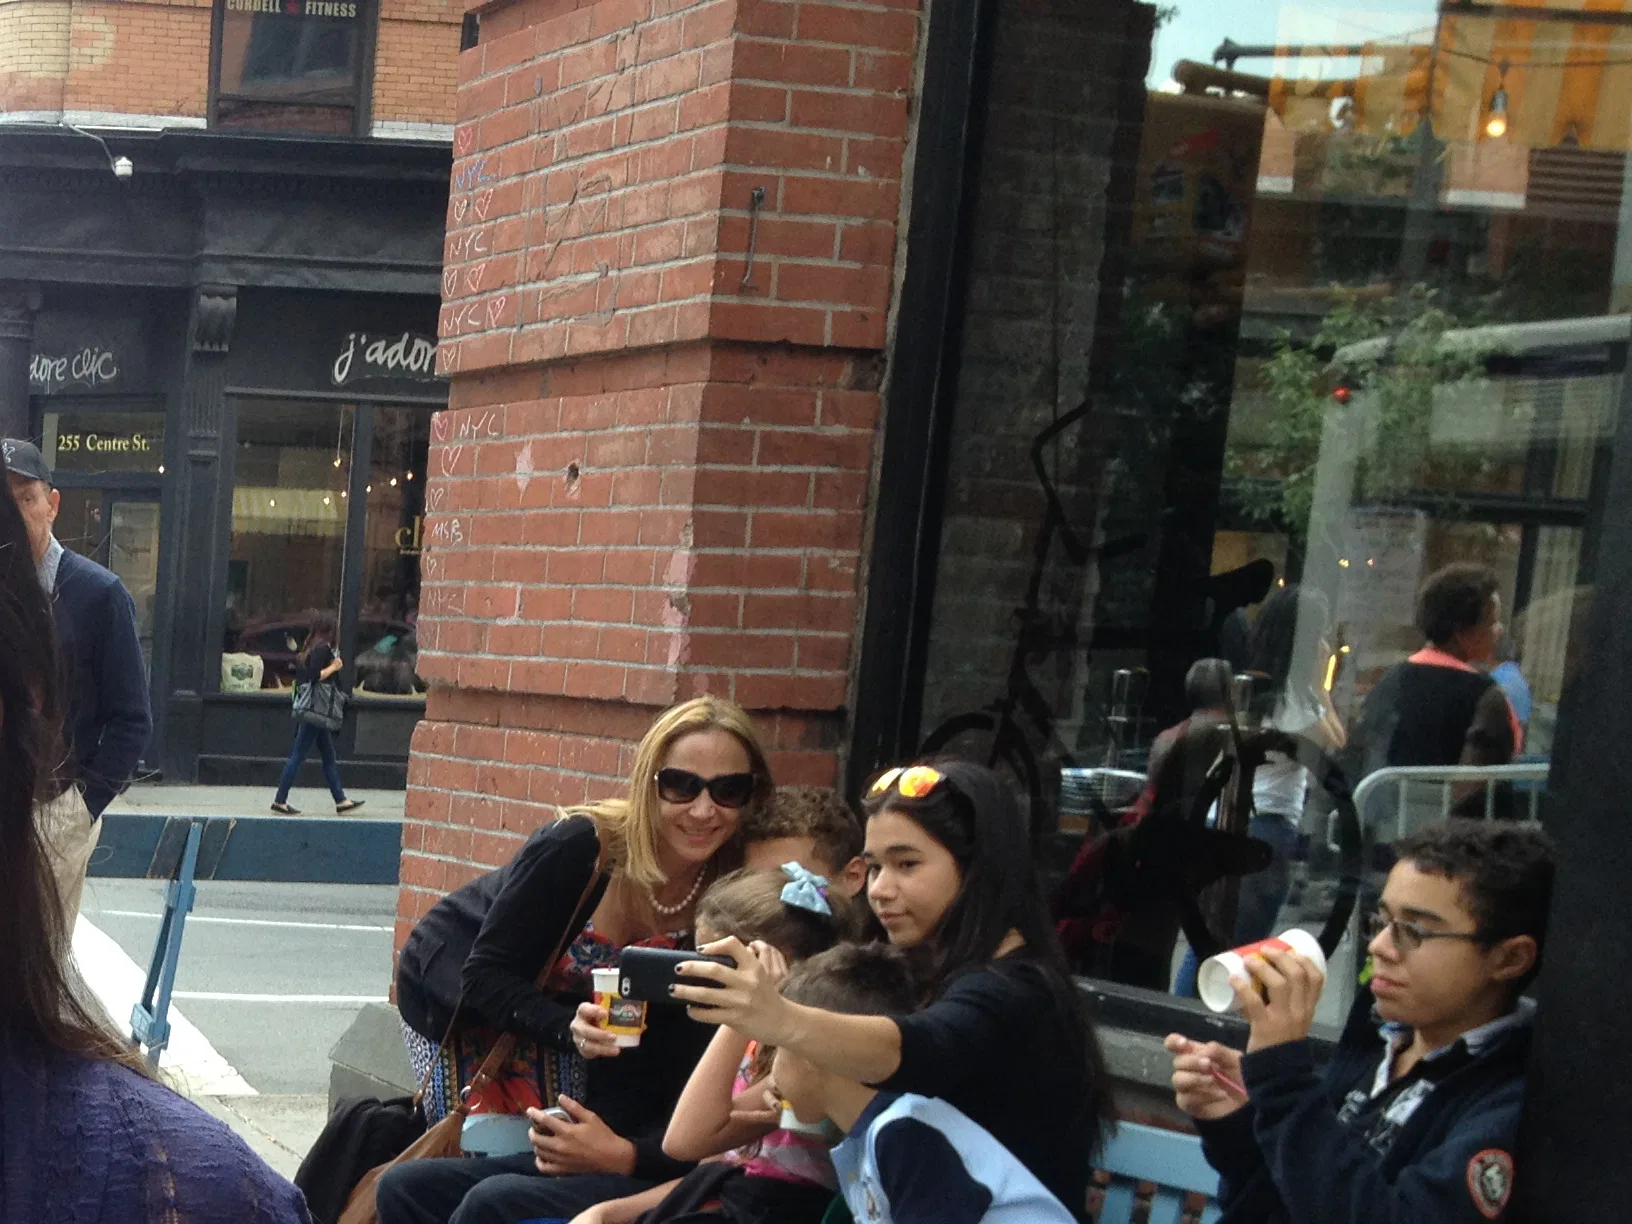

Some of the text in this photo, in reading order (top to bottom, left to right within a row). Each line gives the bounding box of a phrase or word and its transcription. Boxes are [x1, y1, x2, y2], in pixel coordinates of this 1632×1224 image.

[305, 0, 357, 18] FITNESS
[449, 231, 487, 261] NYC
[444, 303, 482, 337] NYC
[459, 411, 499, 440] NYC
[58, 432, 151, 452] 255 Centre St.
